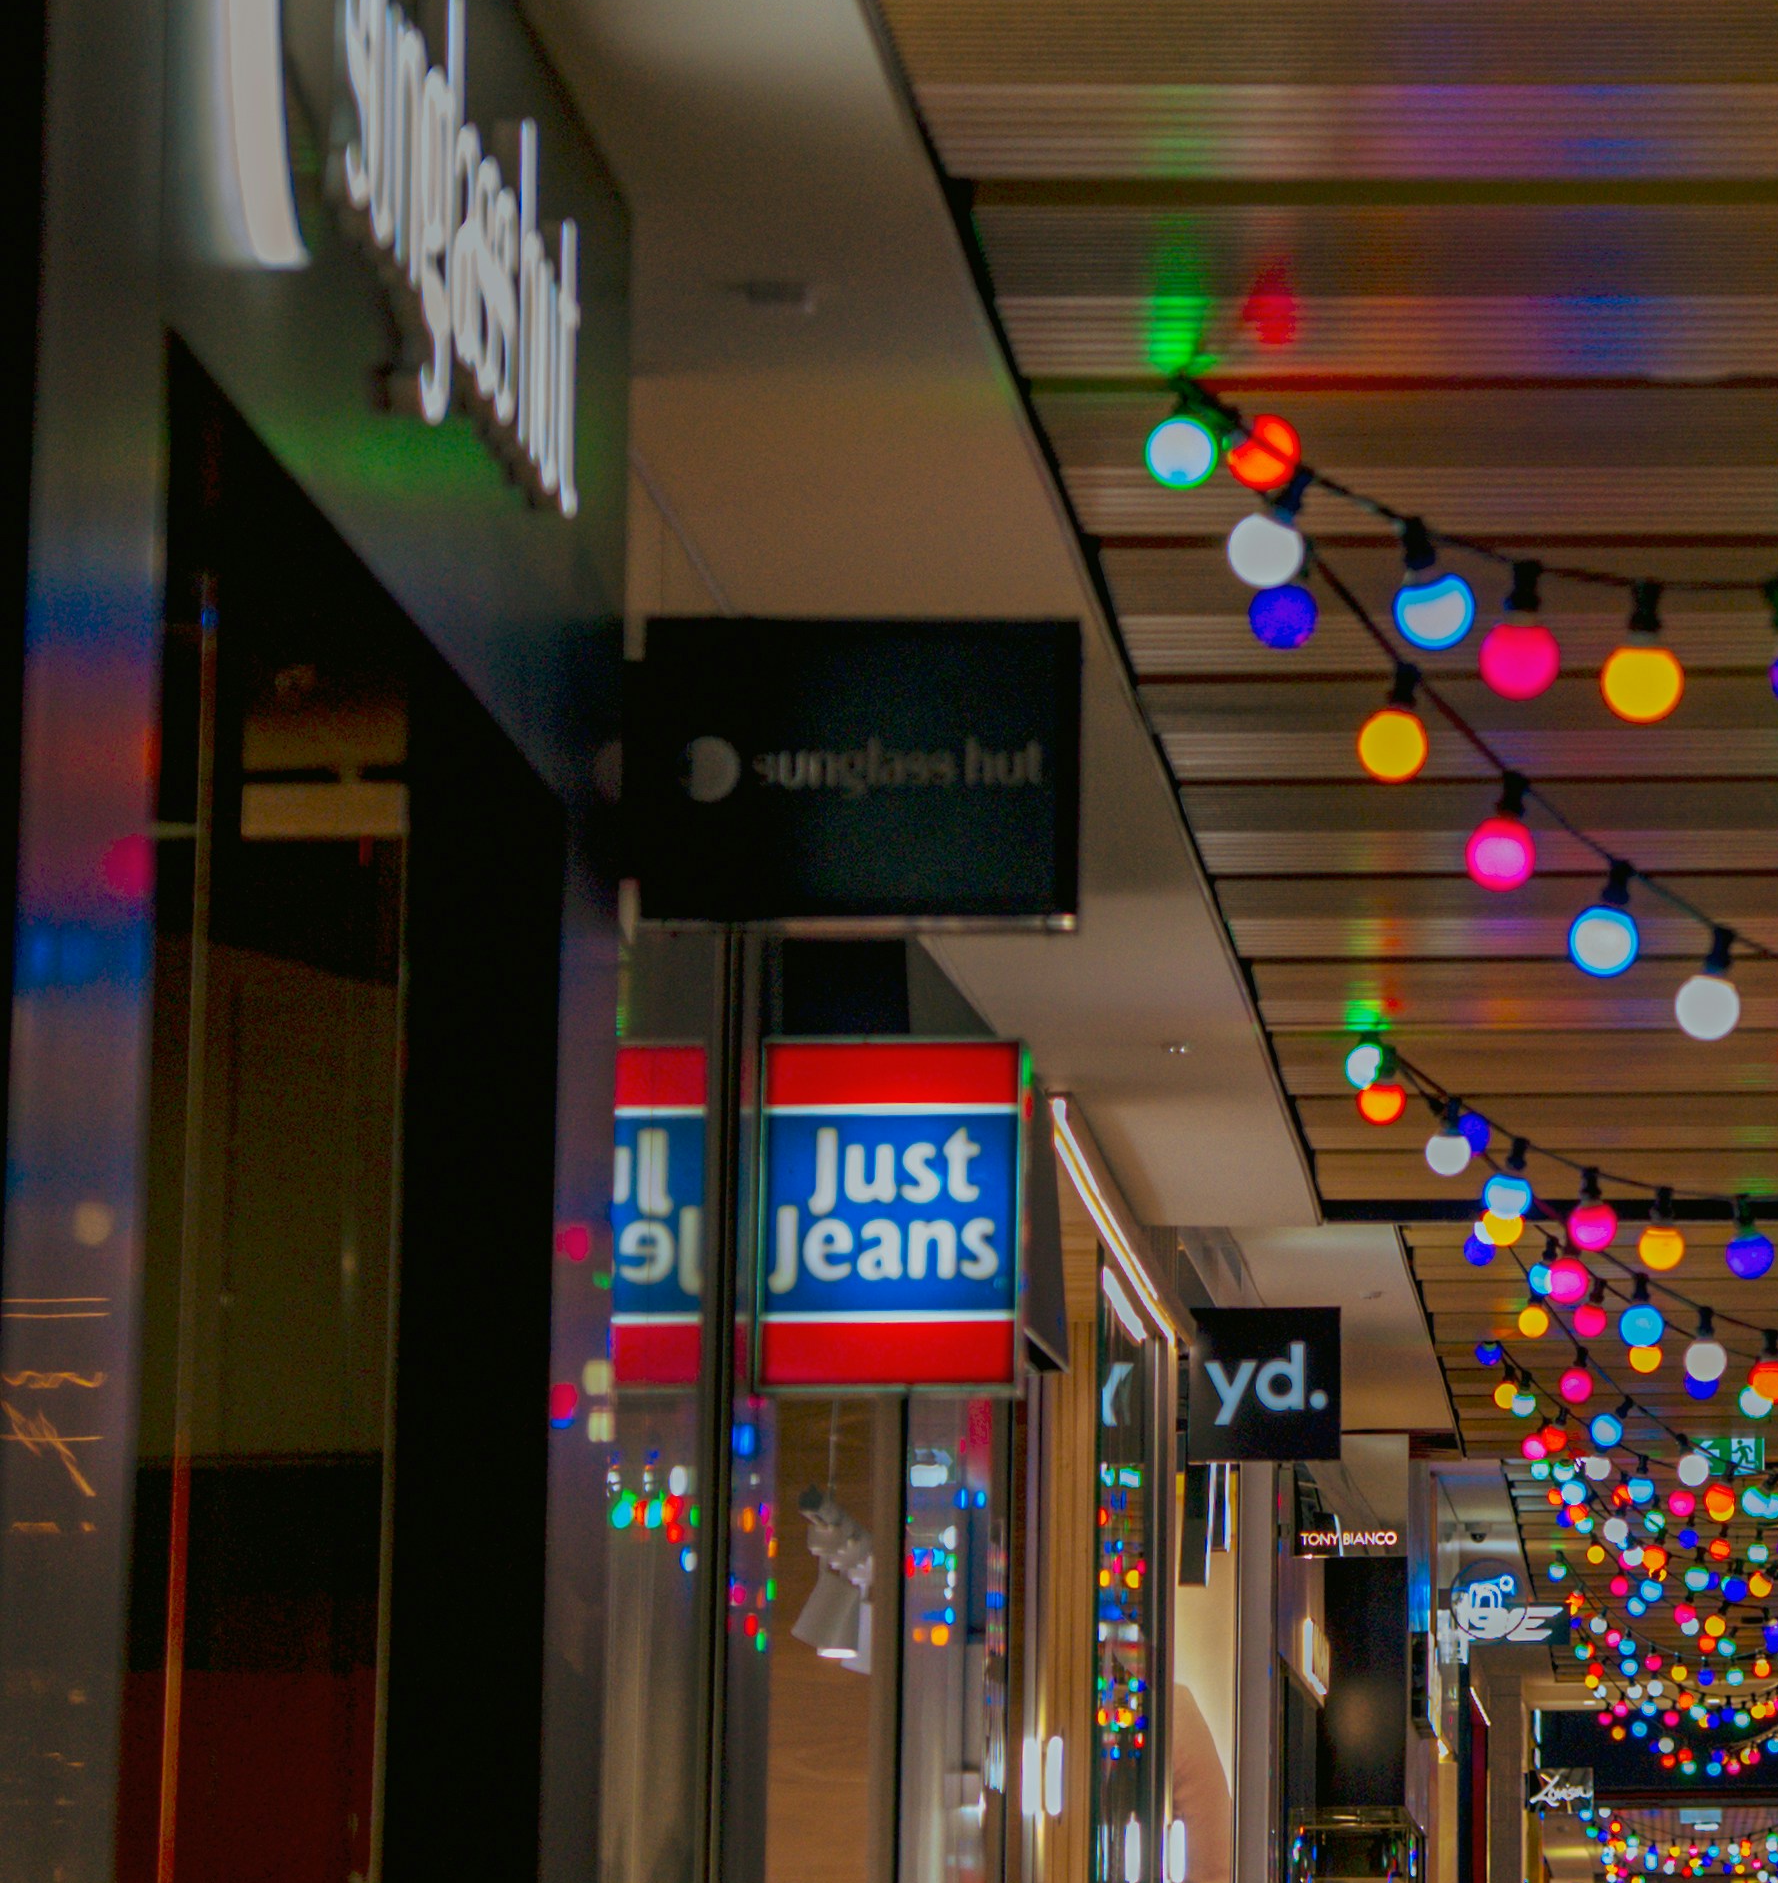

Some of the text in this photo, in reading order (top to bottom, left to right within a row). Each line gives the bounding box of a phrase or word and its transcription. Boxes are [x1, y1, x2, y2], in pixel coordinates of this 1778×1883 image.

[754, 735, 1043, 799] sunglass hut
[808, 1127, 982, 1216] Just
[767, 1204, 1000, 1295] Jeans
[1204, 1340, 1330, 1426] yd.
[1301, 1530, 1397, 1546] TONY BIANCO
